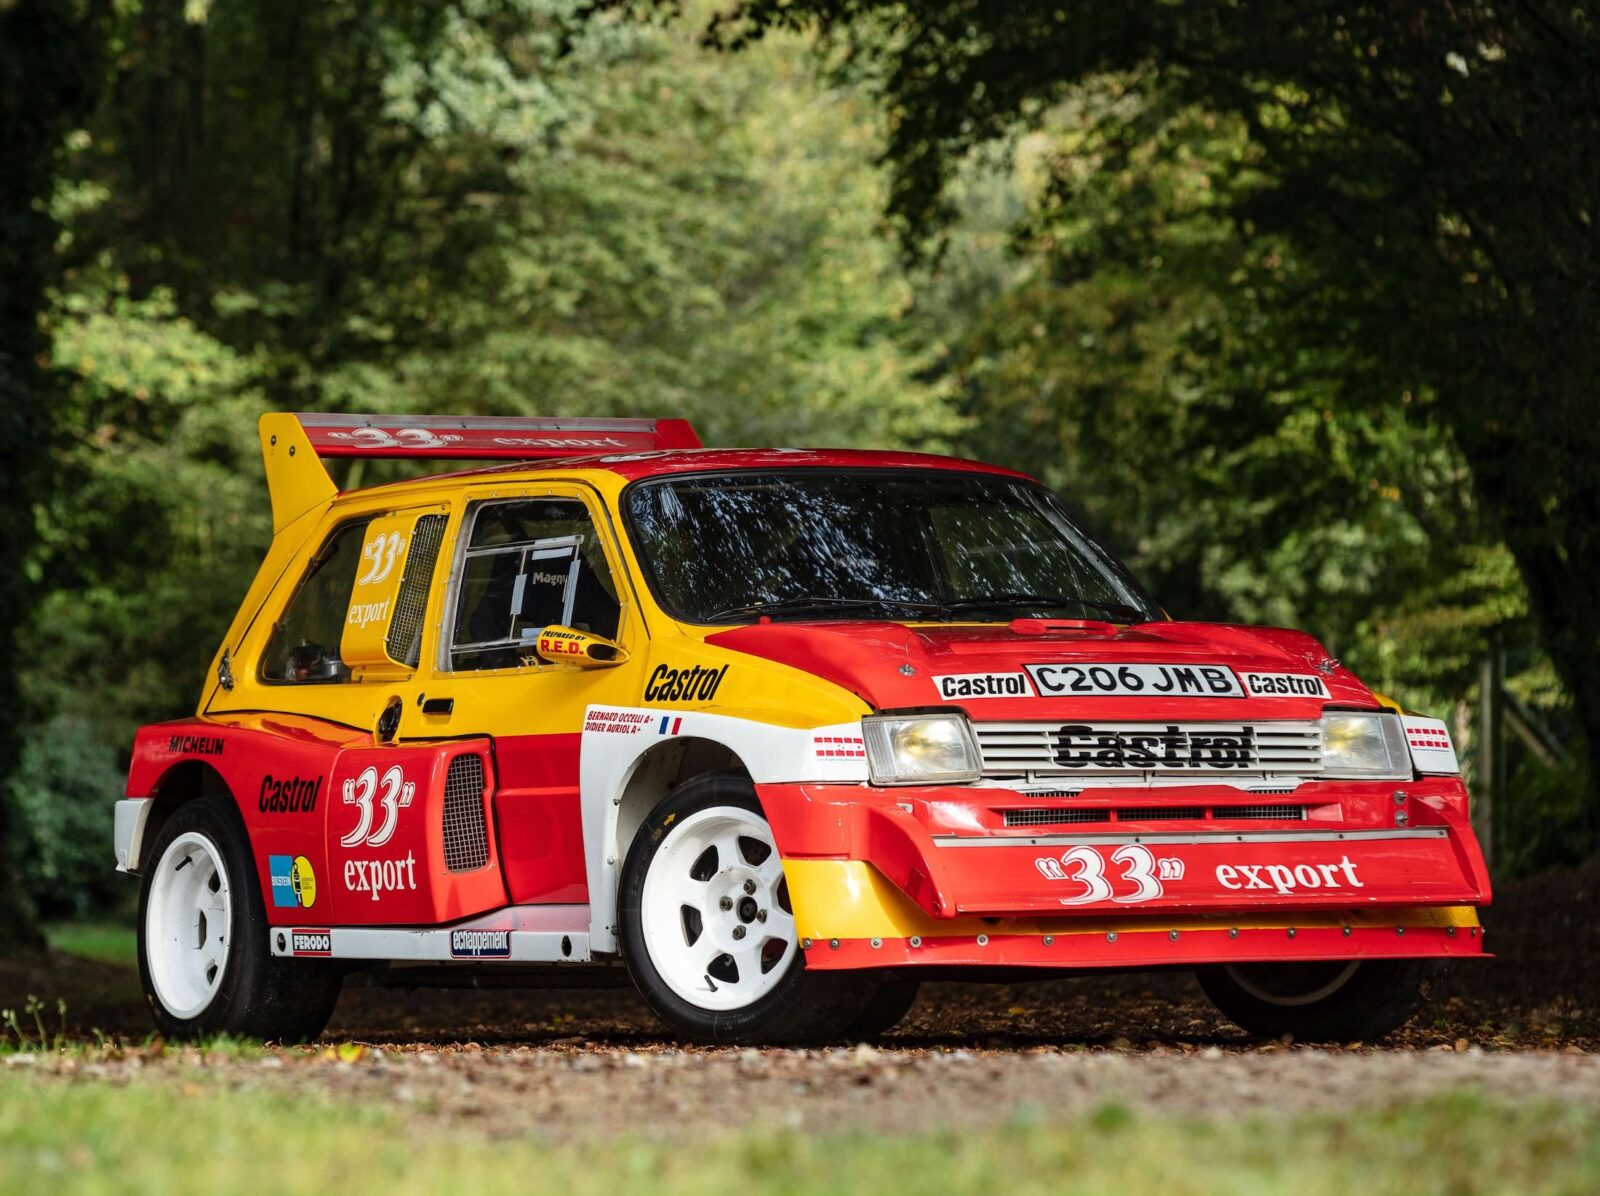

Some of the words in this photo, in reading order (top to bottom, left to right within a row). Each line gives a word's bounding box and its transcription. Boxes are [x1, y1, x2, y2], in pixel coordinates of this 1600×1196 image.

[493, 437, 628, 447] export
[349, 596, 391, 628] export
[542, 630, 575, 639] PREPARED
[540, 639, 584, 655] R.E.D.
[644, 663, 730, 702] Castrol
[942, 674, 1027, 697] Castrol
[1036, 666, 1145, 693] C206
[1153, 667, 1233, 693] JMB
[1248, 674, 1324, 696] Castrol
[587, 710, 618, 722] BERNARD
[619, 713, 644, 723] OCCELLI
[584, 722, 606, 733] DIDIER
[606, 723, 630, 734] AURIOL
[168, 735, 225, 755] MICHELIN
[1053, 725, 1254, 769] Castrol
[258, 774, 323, 813] Castrol
[271, 875, 292, 887] BILSTEIN
[344, 849, 417, 901] export
[1215, 855, 1364, 894] export
[293, 934, 331, 951] FERODO
